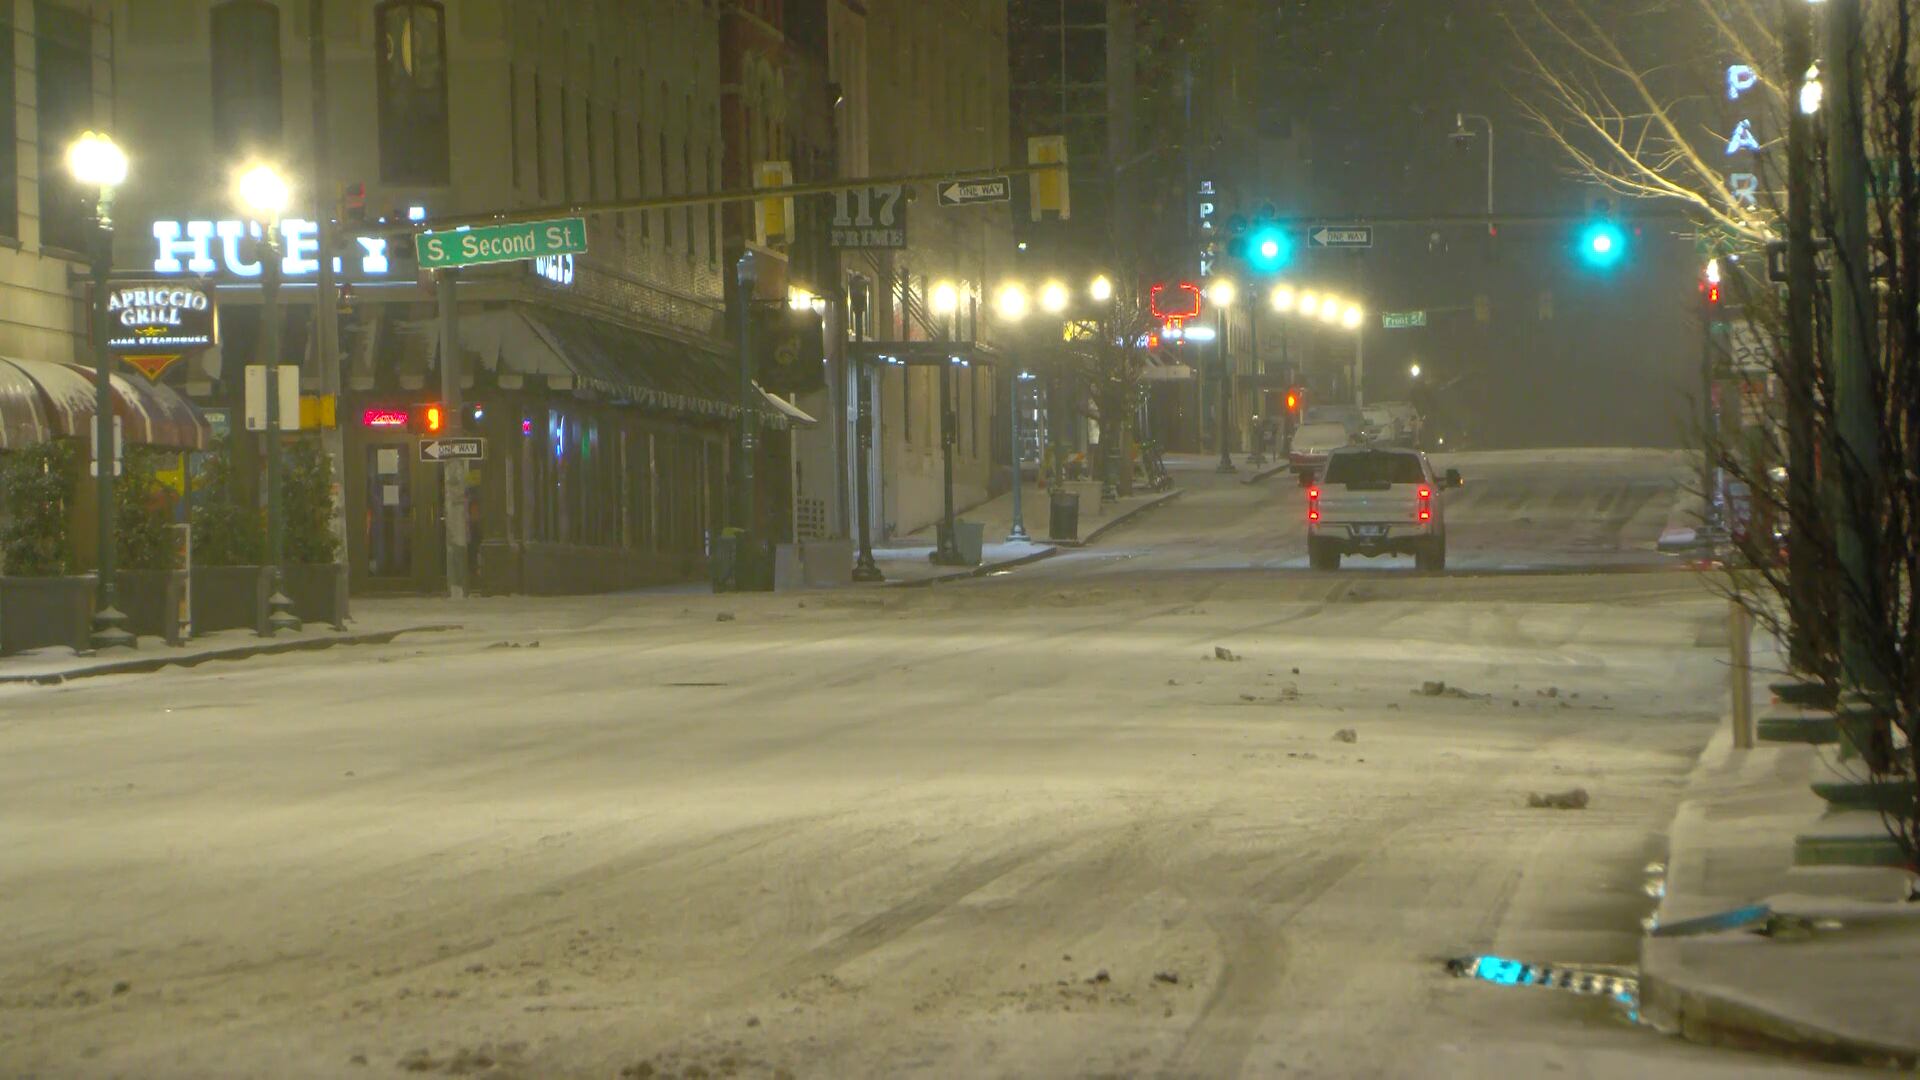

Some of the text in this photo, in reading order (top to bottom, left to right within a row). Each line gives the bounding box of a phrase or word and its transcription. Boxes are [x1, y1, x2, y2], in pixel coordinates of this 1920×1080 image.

[1726, 64, 1761, 206] PAR
[959, 183, 1002, 198] ONE WAY
[830, 186, 903, 227] 117
[427, 226, 579, 262] S. Second St.
[830, 229, 906, 247] PRIME
[1199, 202, 1215, 277] PAK
[1347, 231, 1366, 242] WAY
[108, 287, 208, 311] APRICCIO
[120, 306, 182, 326] GRILL
[458, 443, 477, 454] WAY
